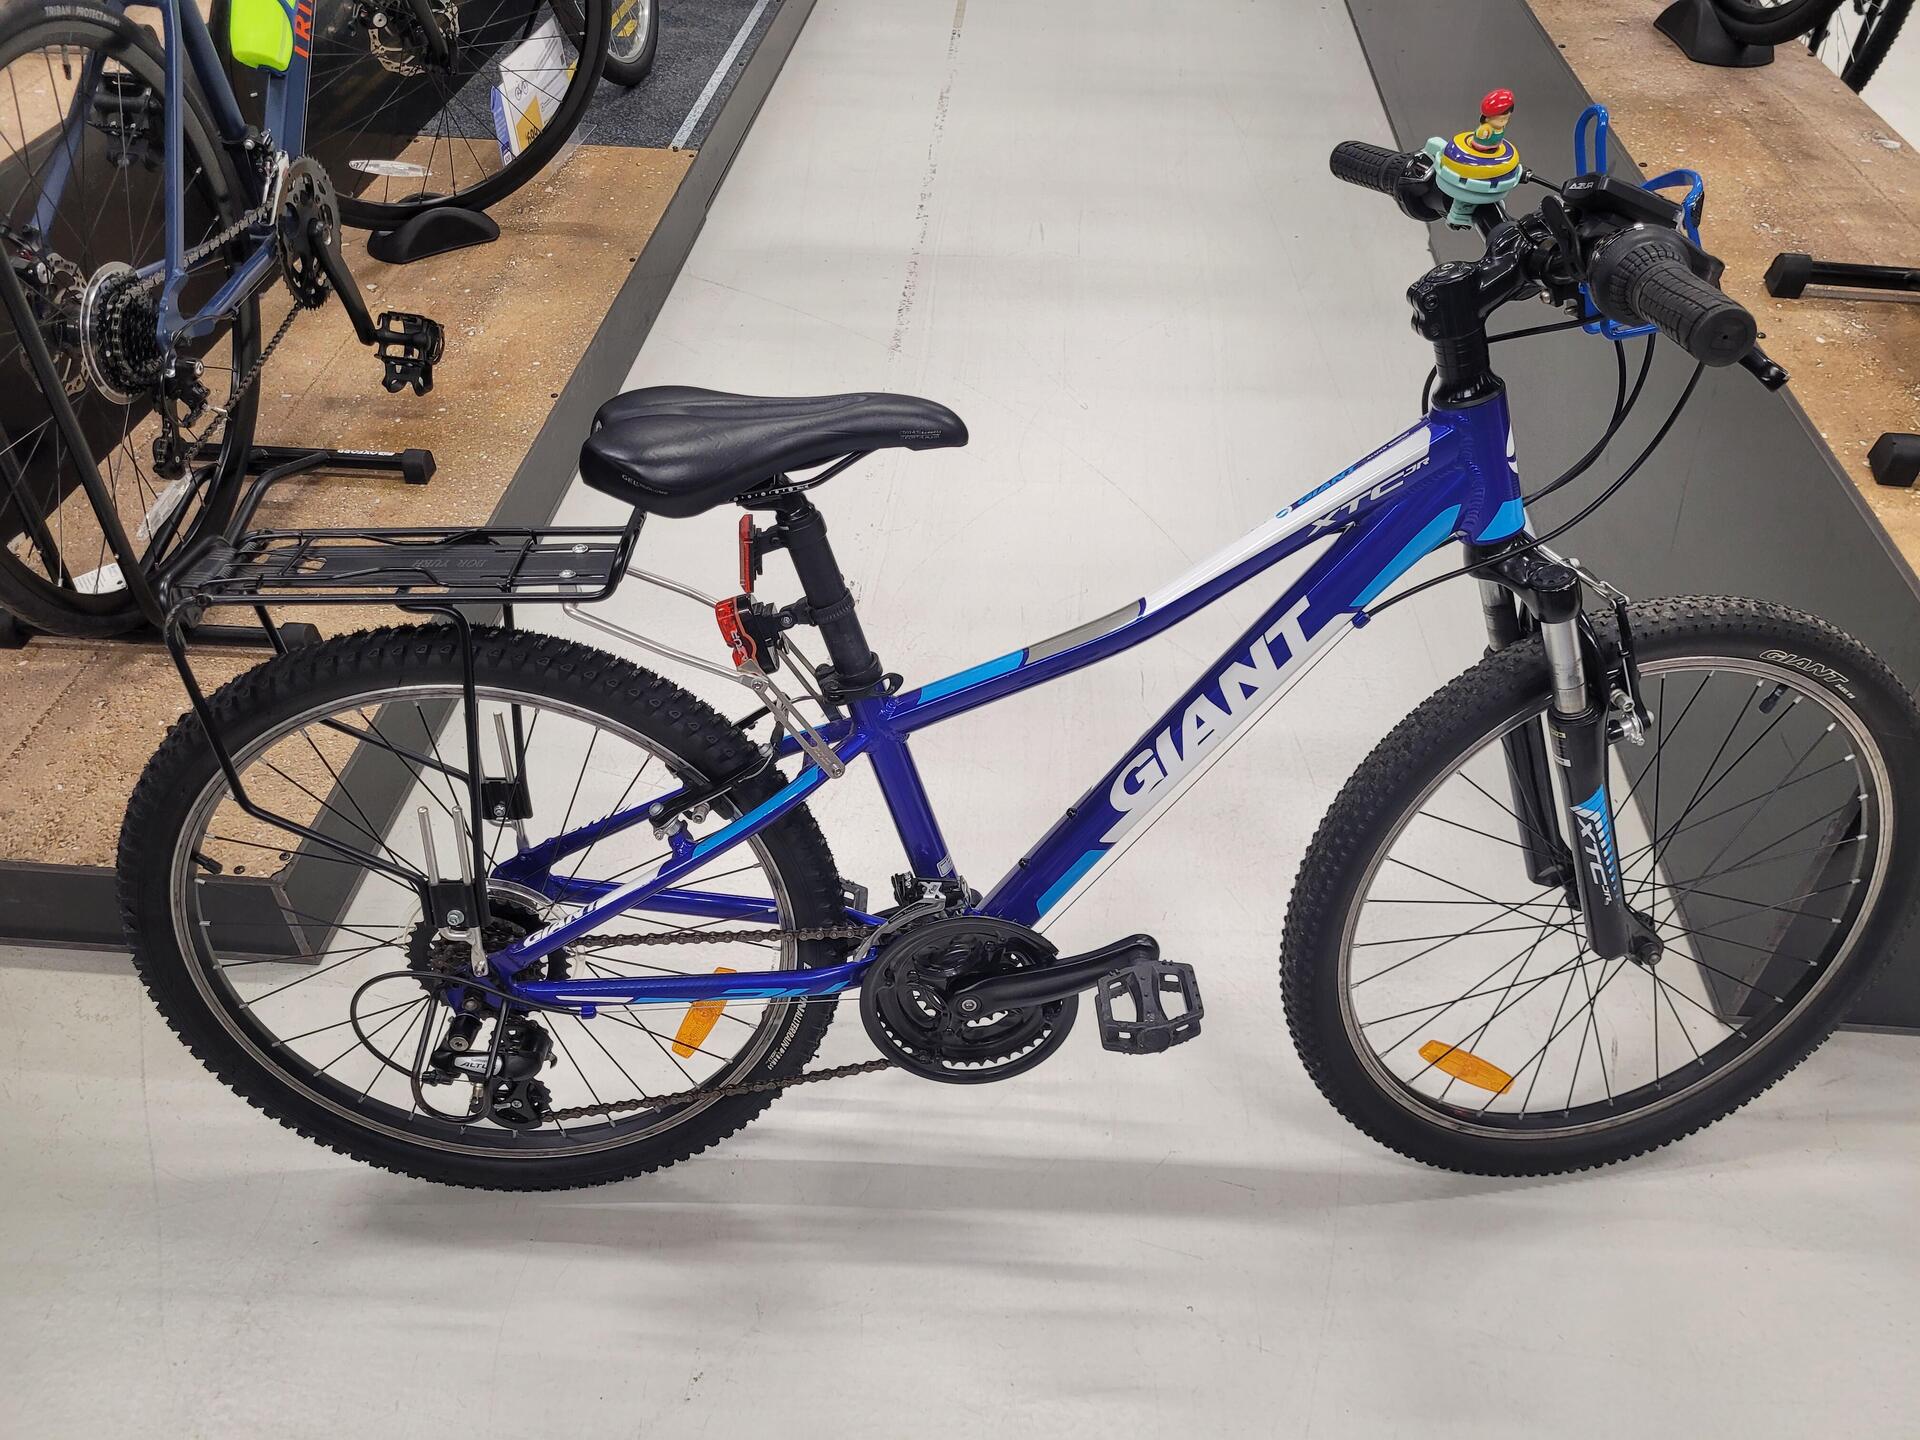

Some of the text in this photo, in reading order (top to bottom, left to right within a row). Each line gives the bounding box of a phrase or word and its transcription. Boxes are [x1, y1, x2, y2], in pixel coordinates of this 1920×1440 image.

[1568, 181, 1594, 190] AZUR
[1297, 466, 1356, 506] GIANT
[1307, 470, 1405, 538] XTC
[1759, 649, 1849, 684] GIANT
[1109, 594, 1311, 812] GIANT
[1576, 816, 1607, 886] XTC
[523, 899, 598, 948] GIANT
[460, 1061, 488, 1070] ALTU
